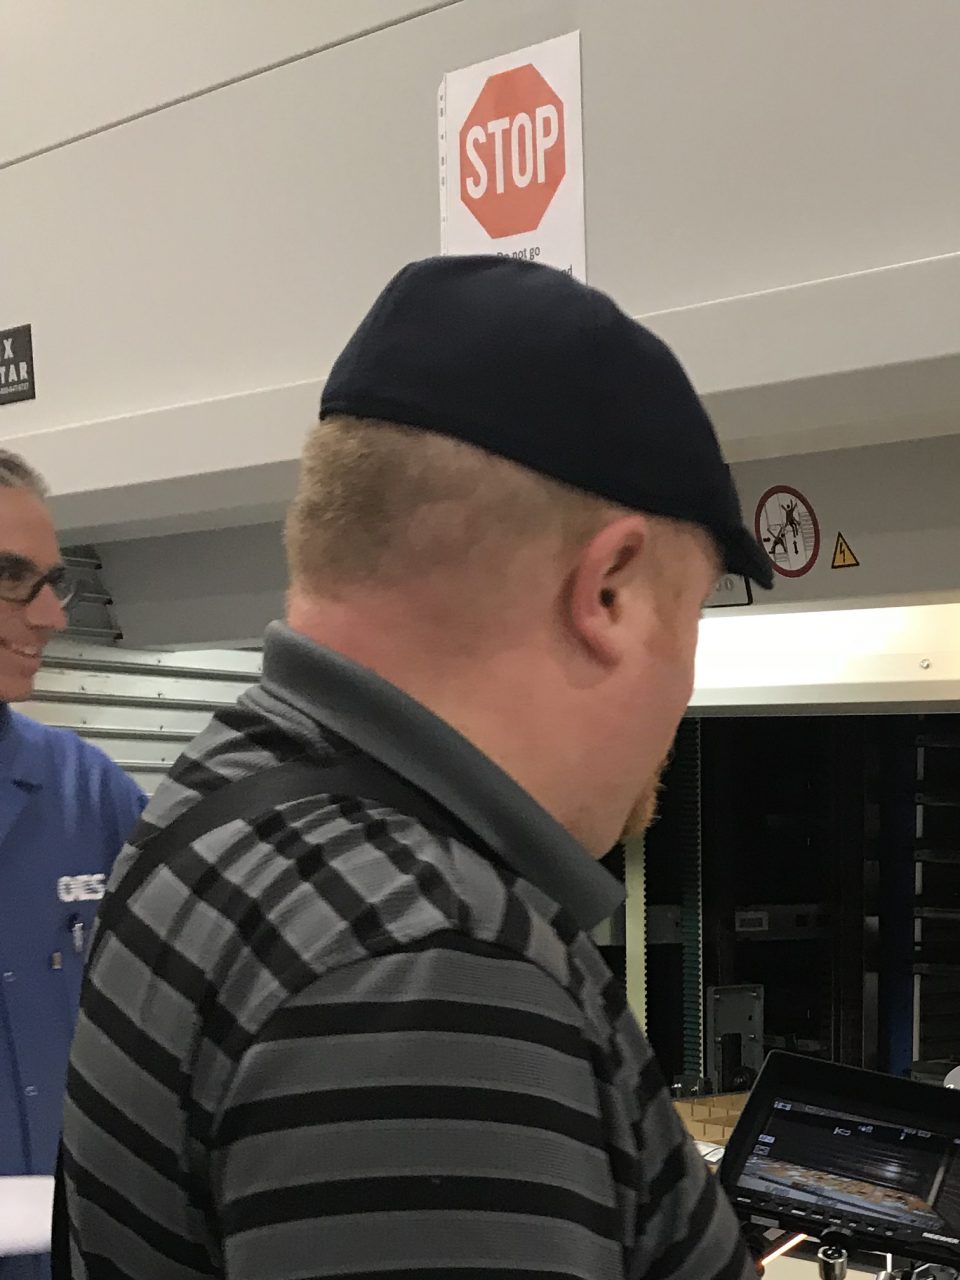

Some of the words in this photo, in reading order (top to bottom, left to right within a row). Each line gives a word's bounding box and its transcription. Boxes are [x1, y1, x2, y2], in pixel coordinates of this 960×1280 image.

[465, 104, 559, 199] STOP
[512, 248, 527, 260] not
[529, 246, 541, 260] go
